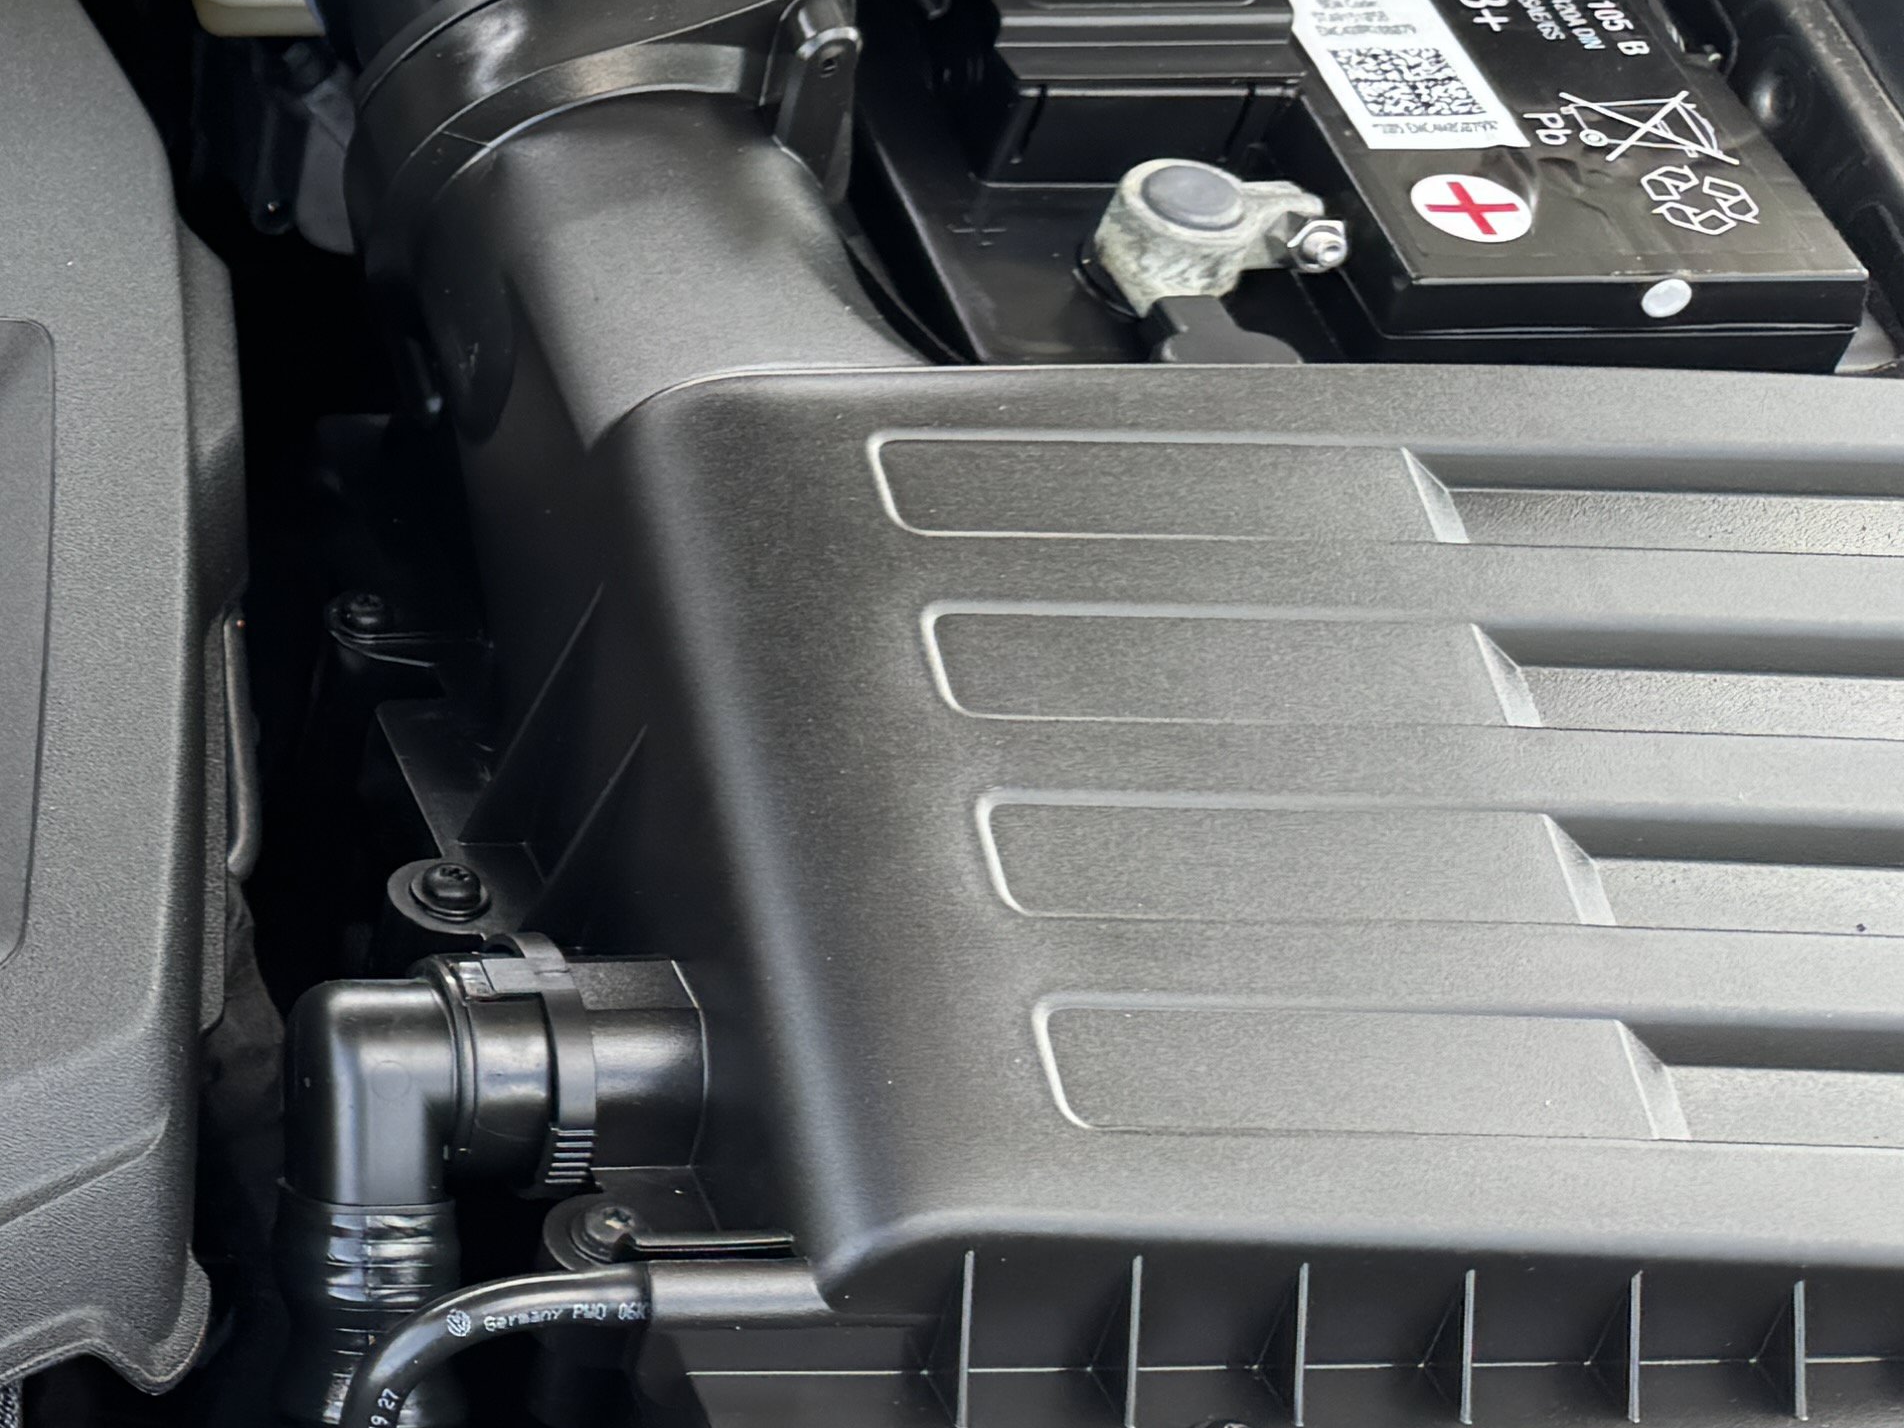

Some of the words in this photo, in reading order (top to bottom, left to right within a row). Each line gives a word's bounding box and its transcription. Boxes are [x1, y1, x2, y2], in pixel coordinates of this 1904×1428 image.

[1587, 0, 1634, 32] 105
[1617, 40, 1651, 56] B
[1523, 112, 1572, 146] Pb
[483, 1309, 565, 1333] Germany
